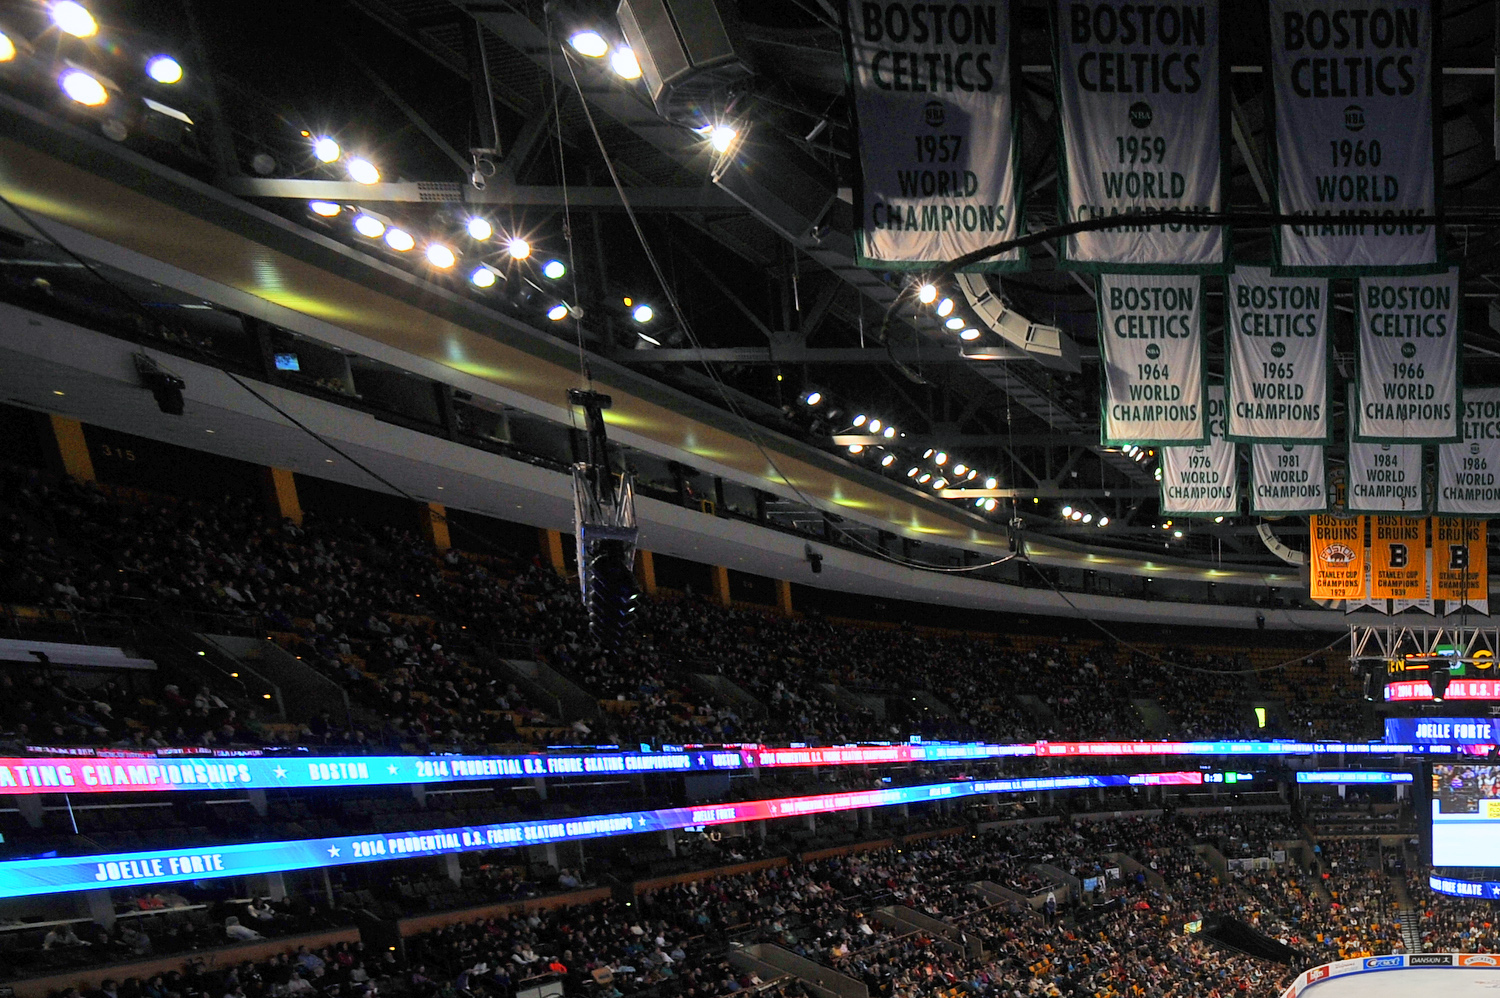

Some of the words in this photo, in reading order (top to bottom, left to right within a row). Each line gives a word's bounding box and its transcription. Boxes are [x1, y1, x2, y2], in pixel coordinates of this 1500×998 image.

[862, 2, 997, 45] BOSTON
[1071, 5, 1204, 46] BOSTON
[1284, 8, 1419, 51] BOSTON
[871, 52, 994, 94] CELTICS
[1077, 52, 1202, 94] CELTICS
[1291, 56, 1416, 98] CELTICS
[914, 135, 962, 164] 1957
[1116, 136, 1167, 165] 1959
[1330, 139, 1382, 168] 1960
[897, 169, 979, 199] WORLD
[1102, 171, 1186, 200] WORLD
[1316, 175, 1399, 203] WORLD
[872, 202, 1007, 234] CHAMPIONS
[1110, 286, 1193, 311] BOSTON
[1237, 284, 1320, 311] BOSTON
[1367, 285, 1451, 311] BOSTON
[1114, 313, 1190, 339] CELTICS
[1240, 312, 1317, 338] CELTICS
[1370, 313, 1447, 338] CELTICS
[1137, 363, 1169, 381] 1964
[1262, 362, 1294, 380] 1965
[1392, 362, 1425, 380] 1966
[1128, 384, 1180, 401] WORLD
[1252, 382, 1304, 400] WORLD
[1383, 383, 1435, 401] WORLD
[1112, 403, 1198, 422] CHAMPIONS
[1235, 401, 1320, 421] CHAMPIONS
[1366, 401, 1451, 421] CHAMPIONS
[1188, 455, 1212, 469] 1976
[1277, 454, 1300, 468] 1981
[1373, 454, 1398, 468] 1984
[1462, 457, 1487, 471] 1986
[1180, 470, 1219, 485] WORLD
[1270, 469, 1309, 484] WORLD
[1366, 468, 1405, 483] WORLD
[1455, 471, 1495, 486] WORLD
[1168, 484, 1232, 500] CHAMPIONS
[1257, 483, 1321, 498] CHAMPIONS
[1353, 483, 1418, 499] CHAMPIONS
[1317, 528, 1357, 540] BRUINS
[1416, 724, 1450, 738] JOELLE
[1454, 724, 1491, 739] FORTE
[82, 763, 252, 786] CHAMPIONSHIPS
[309, 763, 369, 781] BOSTON
[416, 760, 449, 777] 2014
[452, 758, 523, 776] PRUDENTIAL
[525, 757, 547, 774] U.S.
[548, 757, 582, 774] FIGURE
[584, 756, 623, 772] SKATING
[95, 857, 165, 882] JOELLE
[169, 854, 225, 875] FORTE
[352, 841, 386, 858] 2014
[389, 828, 461, 855] PRUDENTIAL
[462, 830, 486, 847] U.S.
[487, 826, 522, 845] FIGURE
[524, 823, 564, 842] SKATING
[1457, 883, 1482, 896] SKATE
[1367, 957, 1400, 968] Crest
